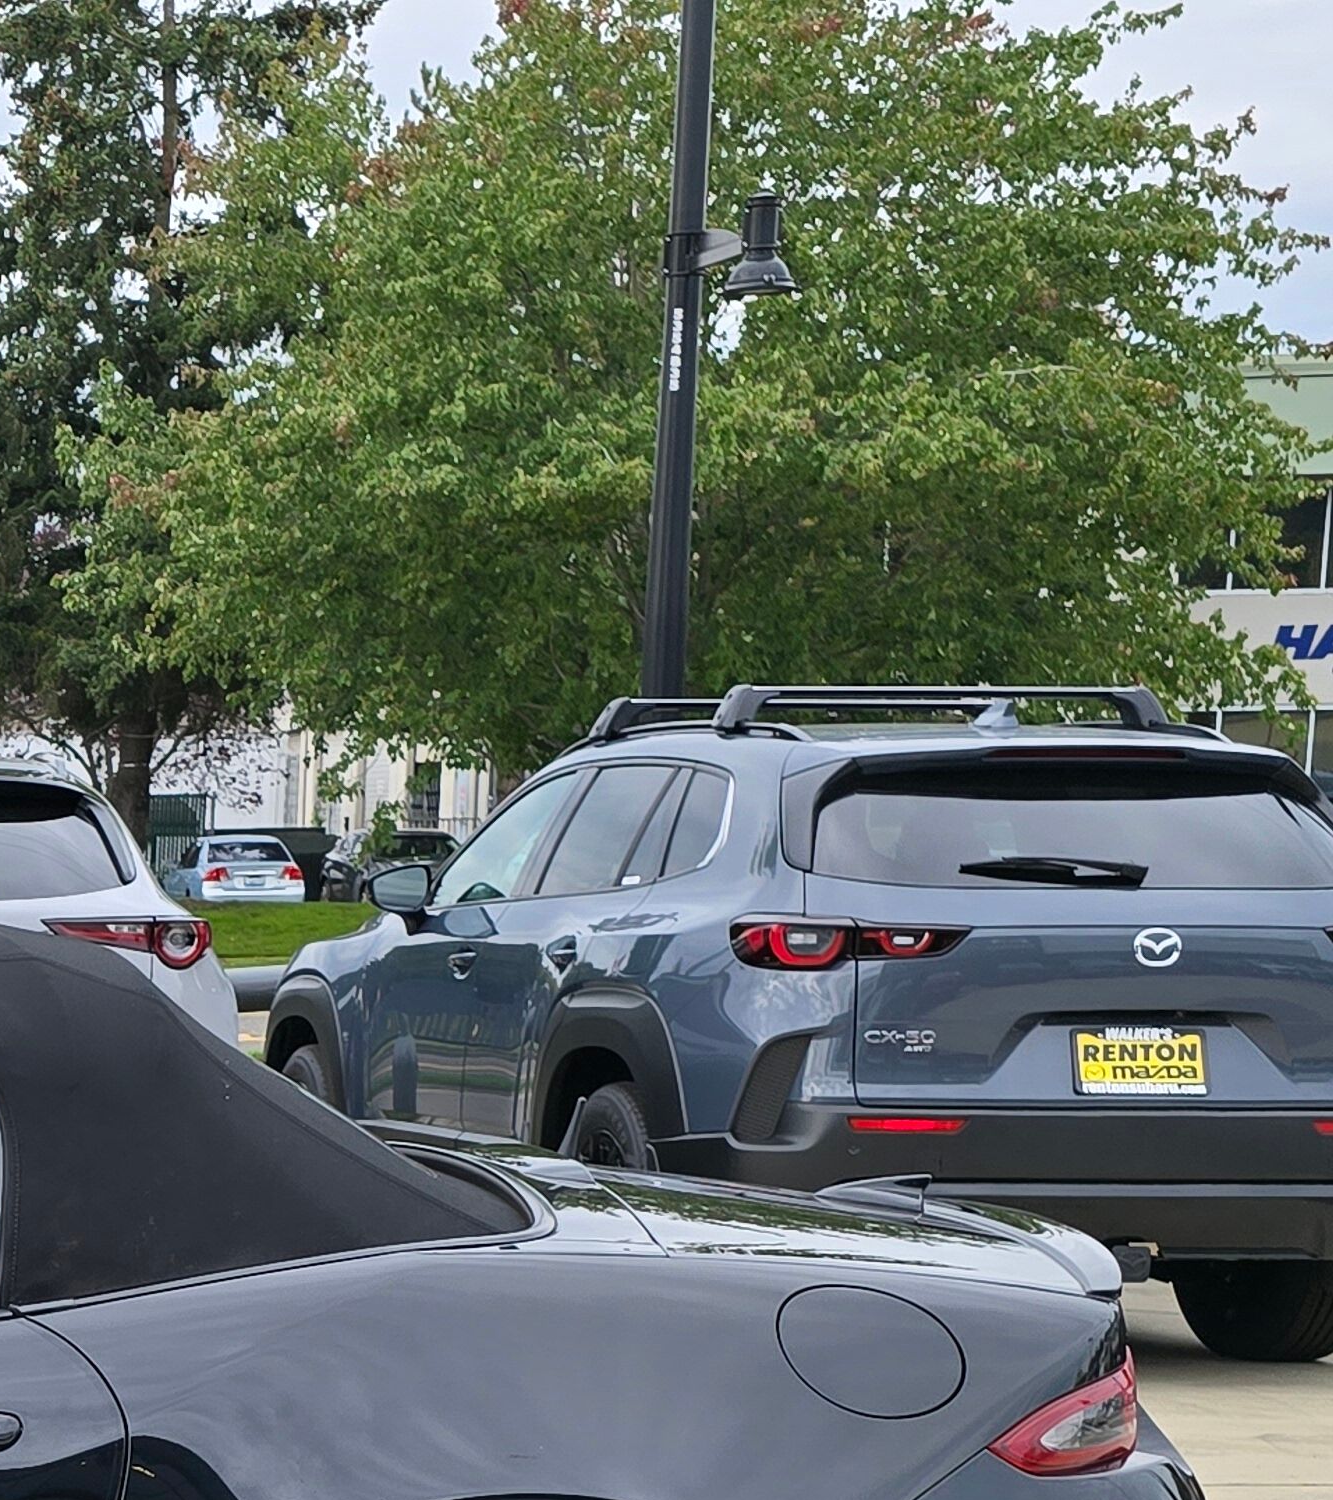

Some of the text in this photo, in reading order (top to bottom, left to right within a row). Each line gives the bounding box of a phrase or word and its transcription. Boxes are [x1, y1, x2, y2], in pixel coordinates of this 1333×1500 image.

[863, 1029, 936, 1044] CX-50
[1104, 1027, 1173, 1041] WALKER'S
[1083, 1043, 1197, 1062] RENTON
